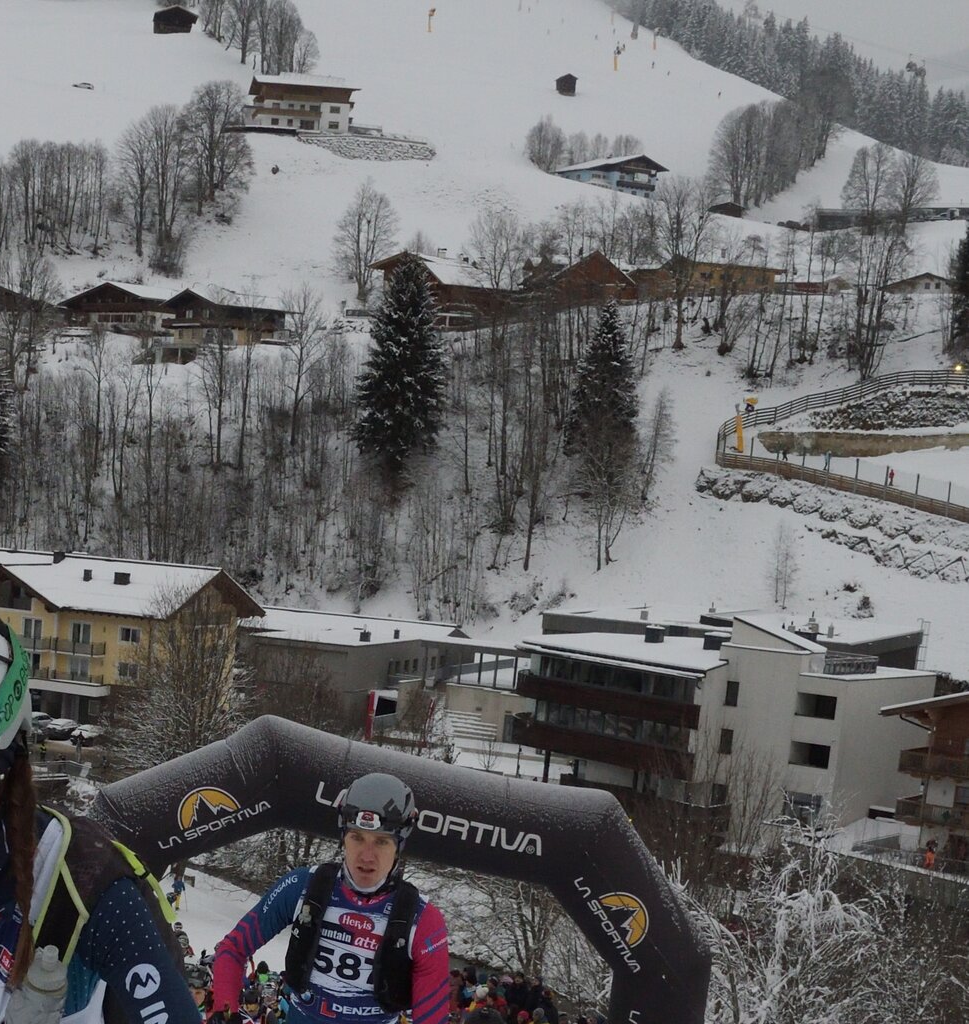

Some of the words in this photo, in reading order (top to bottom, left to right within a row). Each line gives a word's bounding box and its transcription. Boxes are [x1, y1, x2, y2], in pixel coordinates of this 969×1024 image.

[158, 835, 182, 850] LA
[184, 800, 271, 841] SPORTIVA
[417, 809, 542, 857] ORTIVA
[342, 915, 372, 931] Hervis
[574, 877, 591, 898] LA
[587, 900, 642, 973] SPORTIVA
